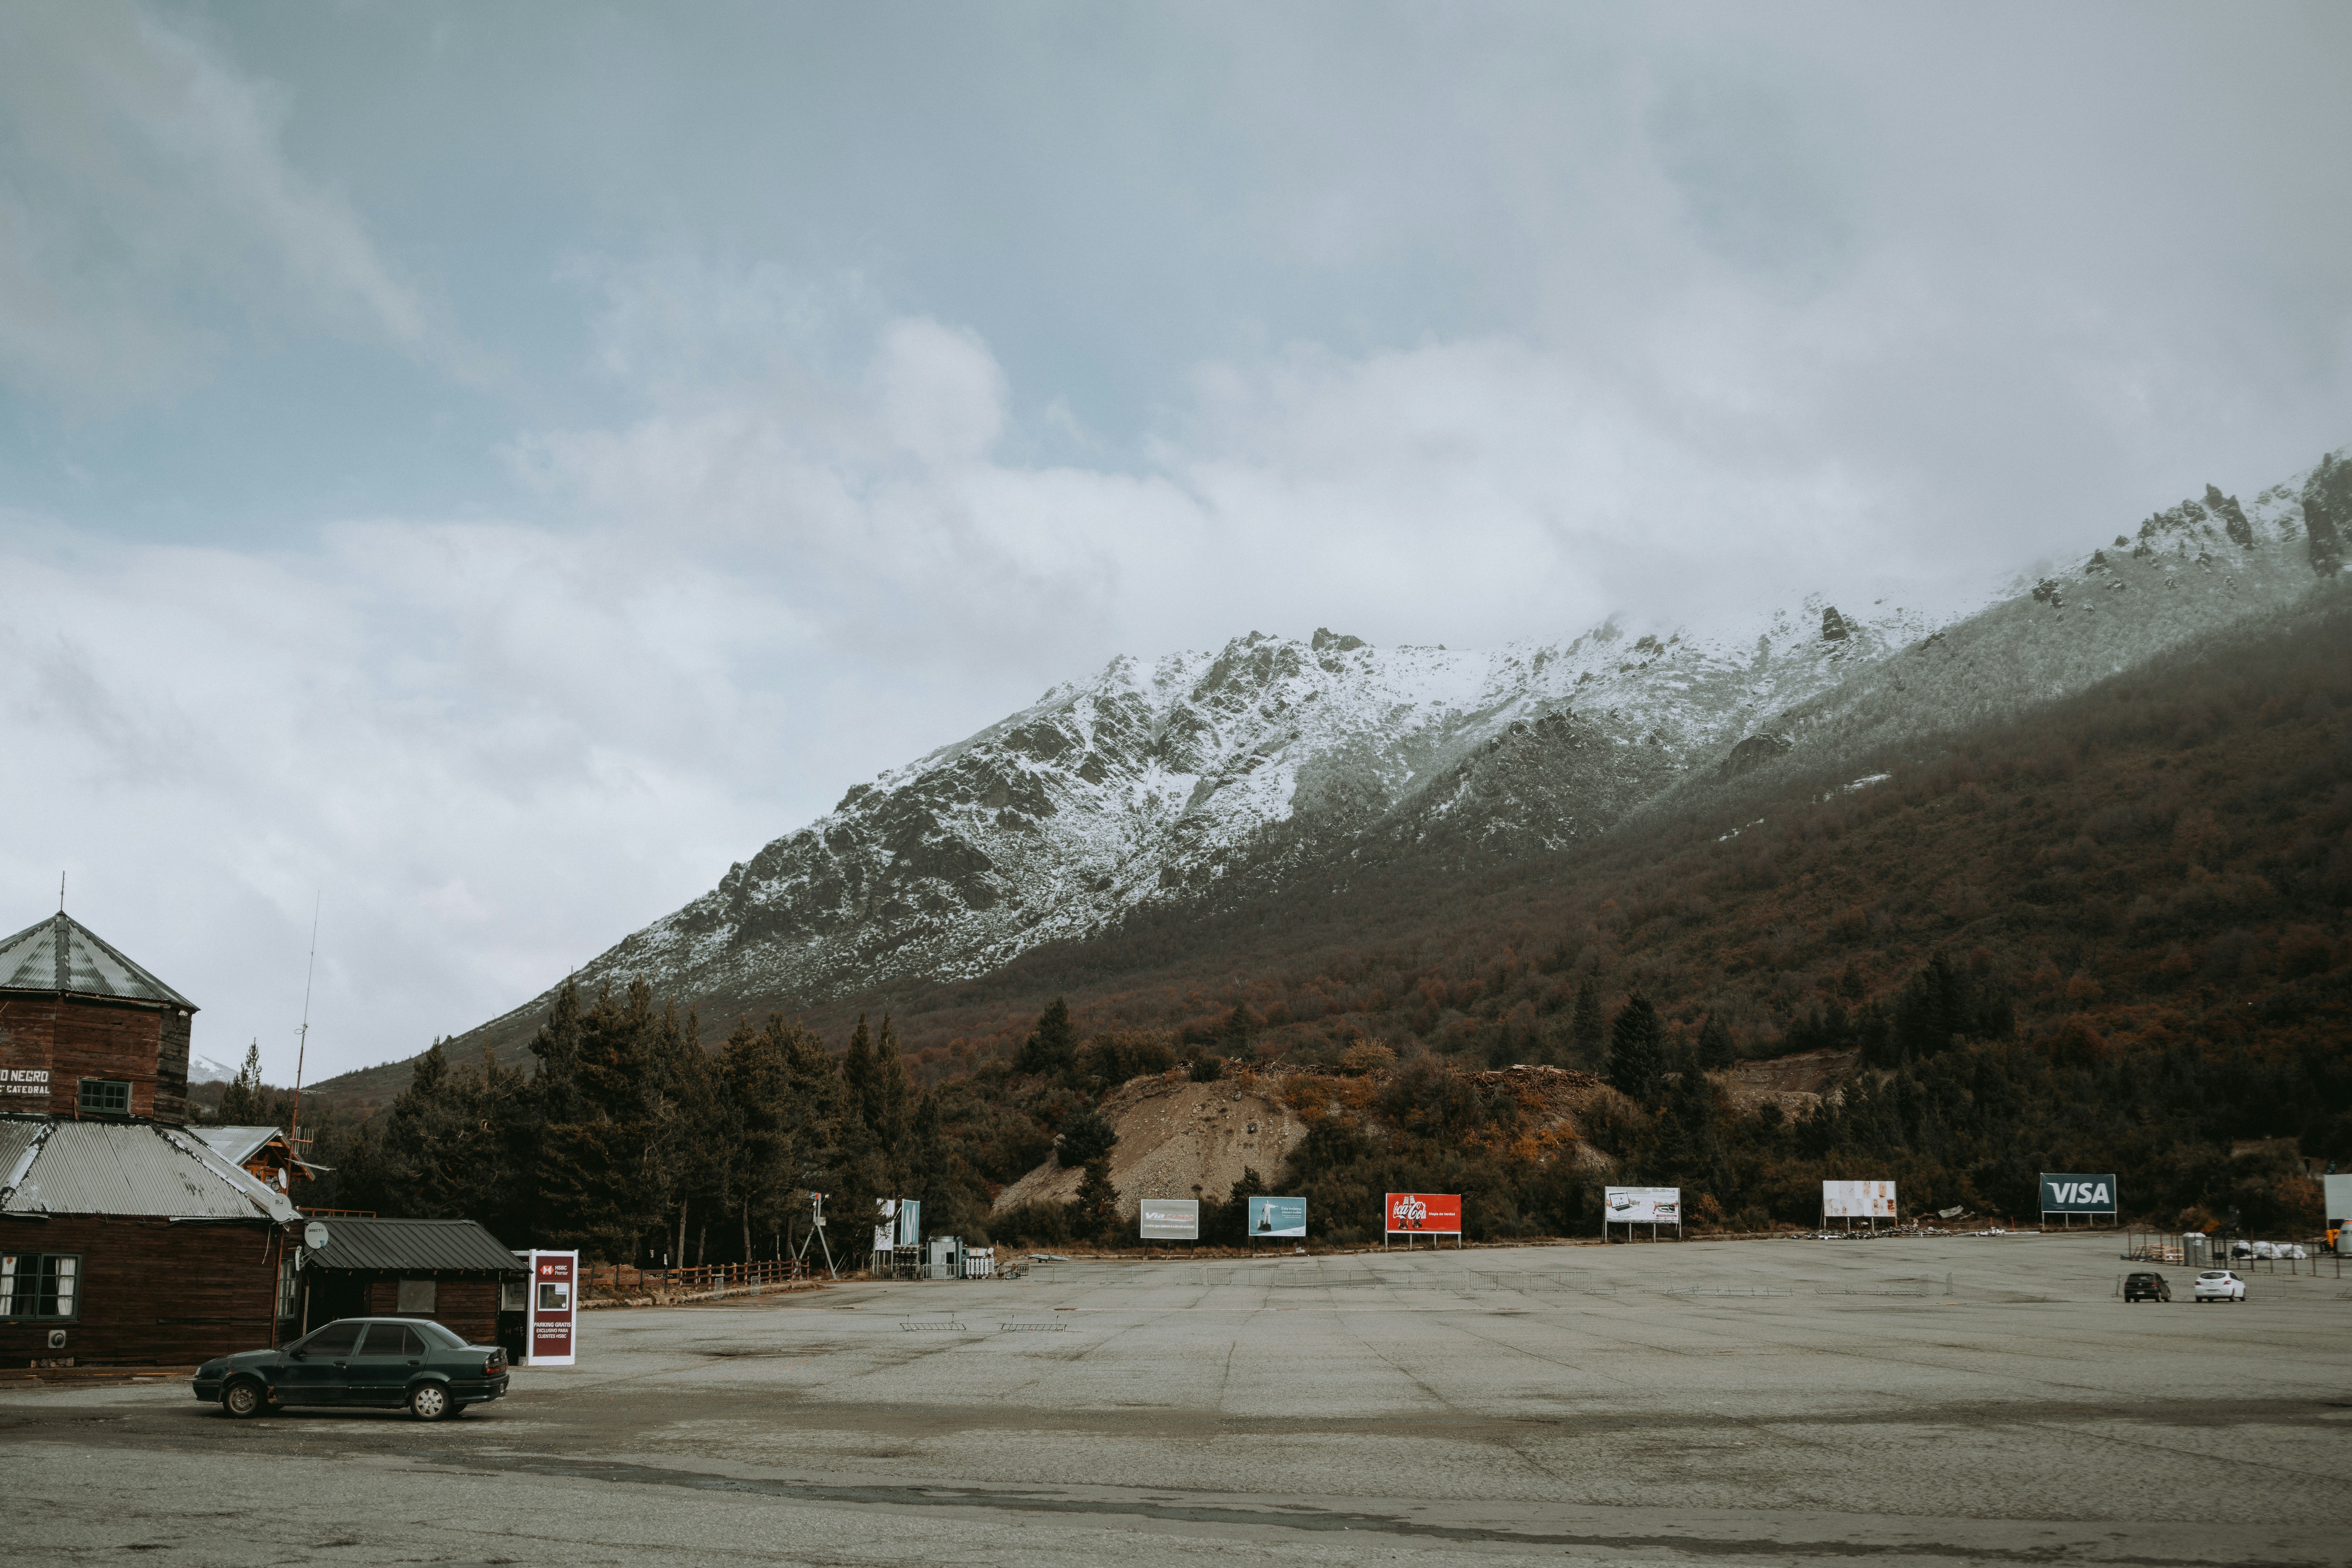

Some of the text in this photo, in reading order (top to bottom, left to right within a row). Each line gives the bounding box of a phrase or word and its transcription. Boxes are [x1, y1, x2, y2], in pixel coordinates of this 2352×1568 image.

[11, 1070, 48, 1082] NEGRO
[7, 1085, 50, 1094] CATEDRAL
[2047, 1183, 2110, 1203] VISA
[1393, 1201, 1426, 1220] Coca-Cola
